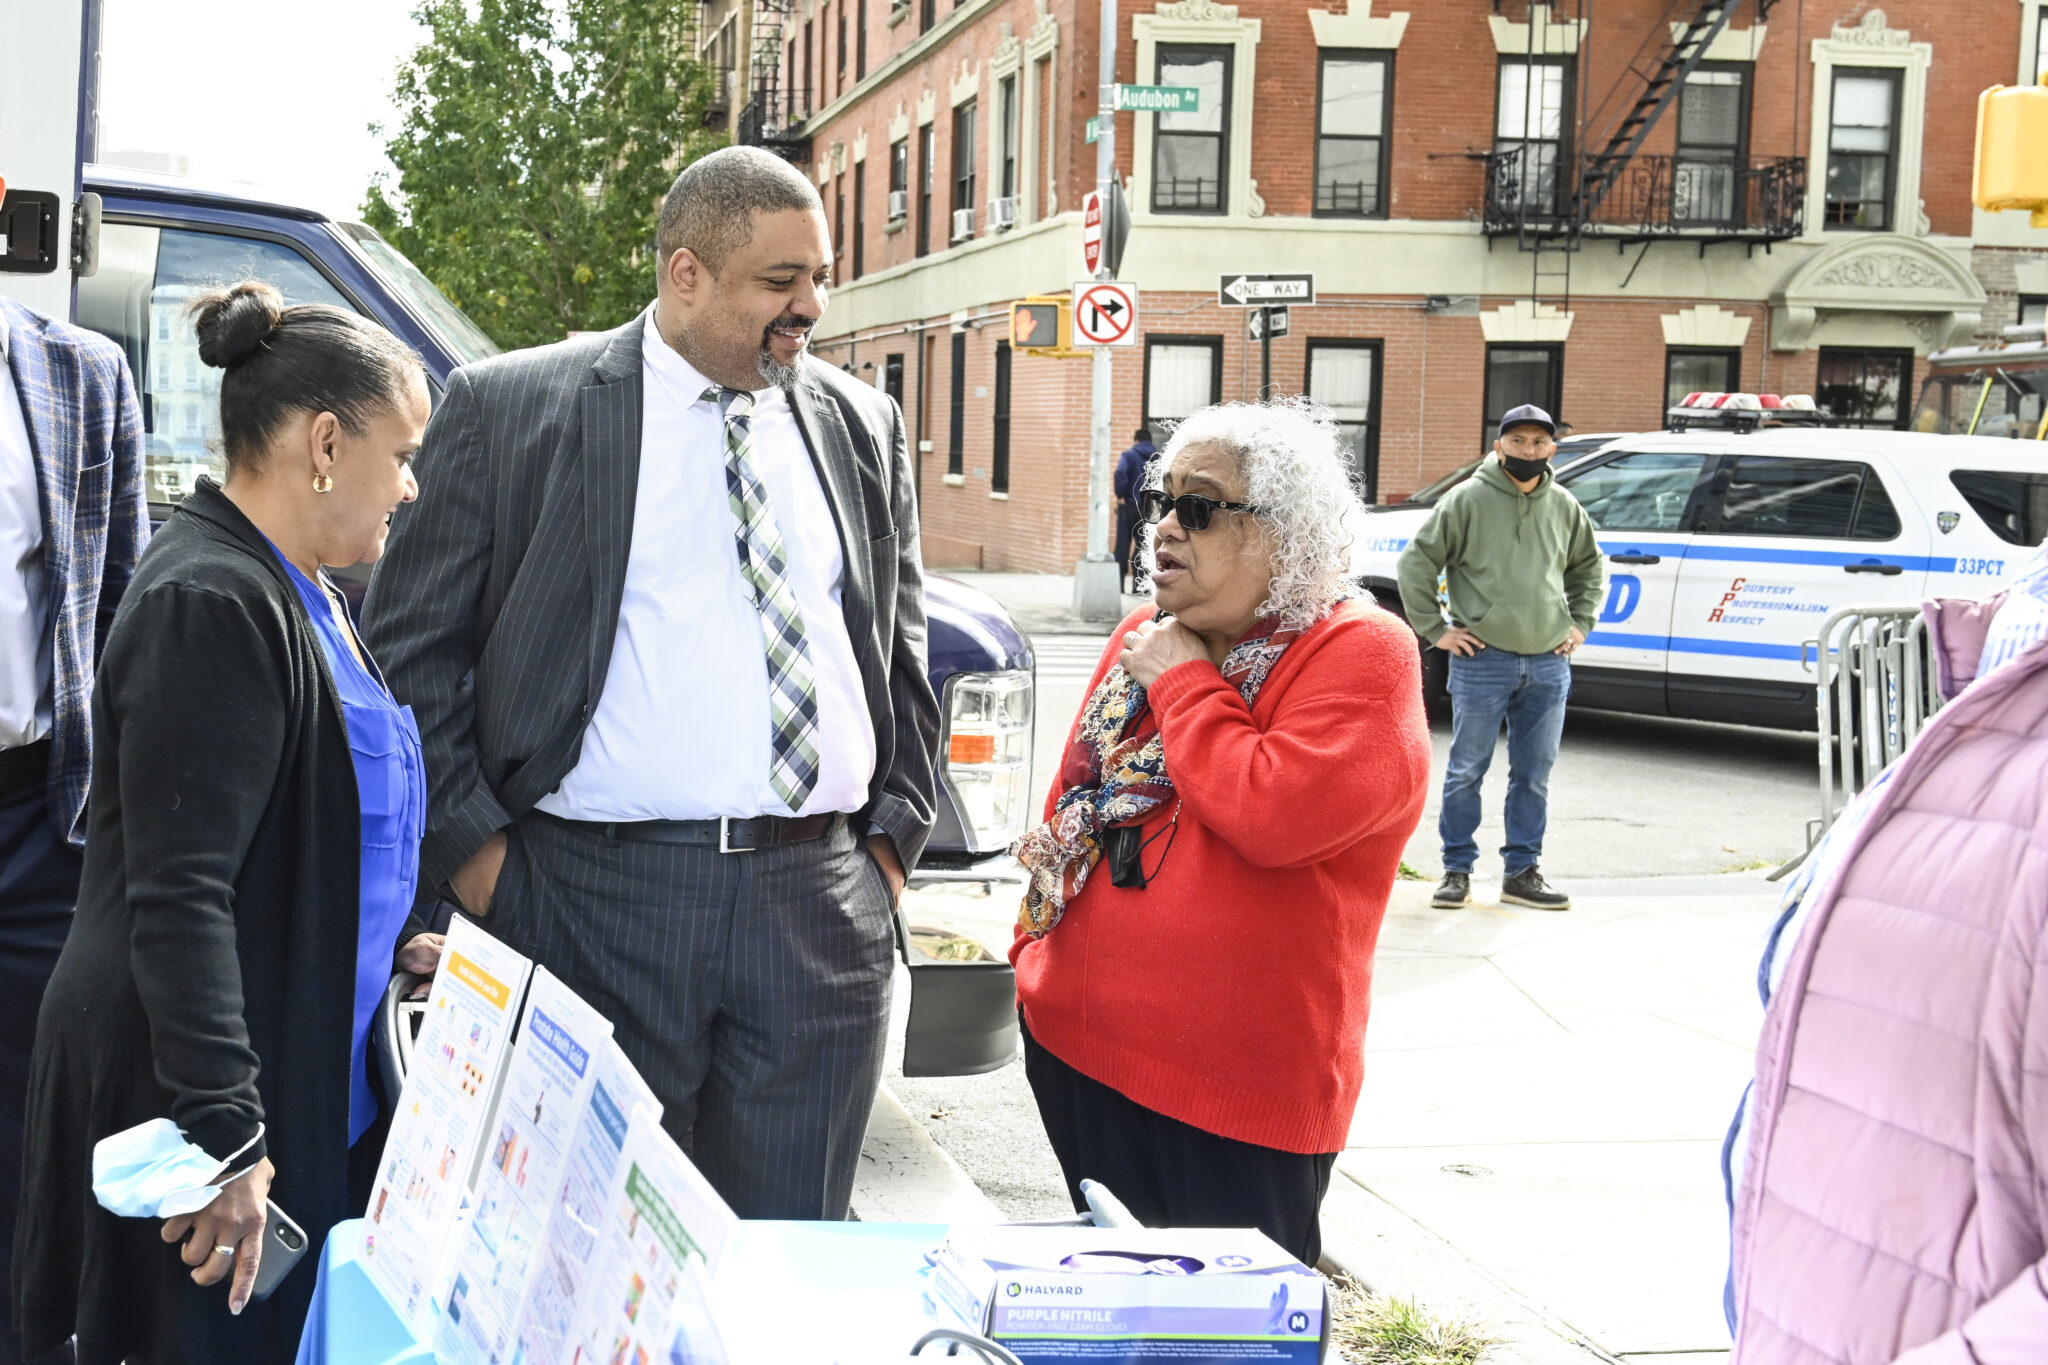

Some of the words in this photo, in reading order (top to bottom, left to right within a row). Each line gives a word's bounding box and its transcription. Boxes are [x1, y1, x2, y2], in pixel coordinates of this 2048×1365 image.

[1121, 88, 1180, 108] Audubon
[1184, 90, 1196, 102] Av
[1234, 283, 1260, 296] ONE
[1273, 283, 1302, 295] WAY
[1959, 558, 2005, 576] 33PCT
[1730, 577, 1795, 595] COURTESY
[1719, 592, 1829, 613] PROFESSIONALISM
[1707, 608, 1765, 625] RESPECT
[1024, 1285, 1083, 1296] HALYARD
[1007, 1308, 1056, 1321] PURPLE
[1059, 1310, 1113, 1323] NITRILE
[1291, 1315, 1306, 1330] M
